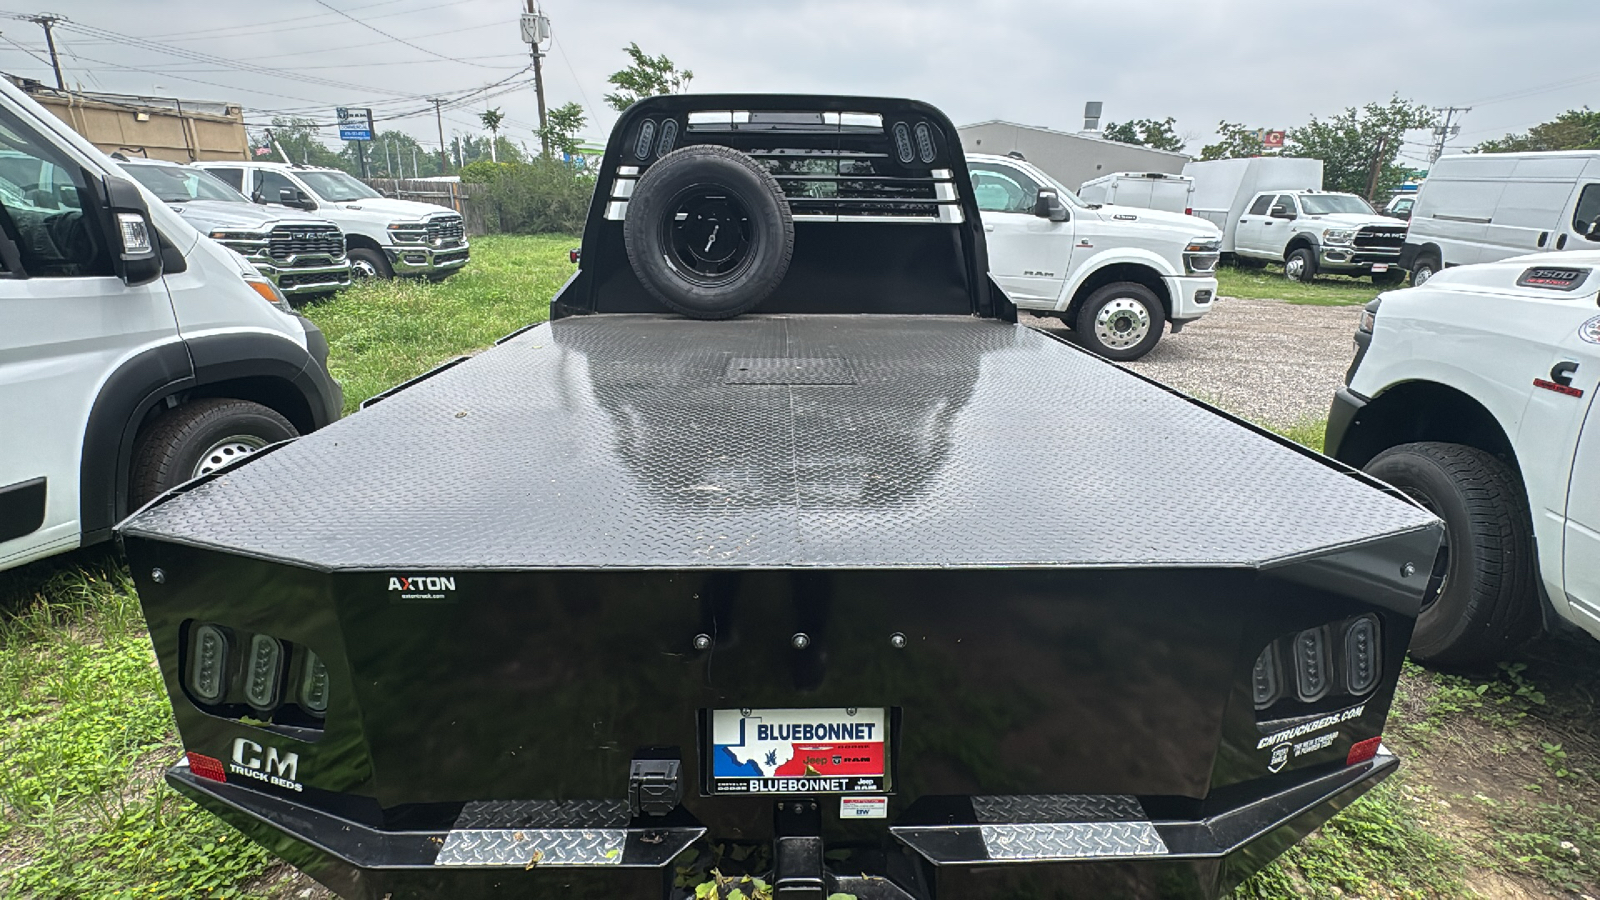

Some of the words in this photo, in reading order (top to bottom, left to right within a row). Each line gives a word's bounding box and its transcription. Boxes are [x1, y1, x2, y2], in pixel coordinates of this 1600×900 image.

[1533, 269, 1578, 280] 3500
[388, 576, 456, 591] AXTON
[757, 723, 875, 741] BLUEBONNET
[1256, 705, 1365, 749] CMTRUCKBEDS.COM
[232, 737, 299, 781] CM
[802, 756, 828, 765] Jeep
[229, 763, 269, 783] TRUCK
[270, 776, 303, 793] BEDS
[750, 779, 849, 792] BLUEBONNET
[857, 778, 874, 786] Jeep
